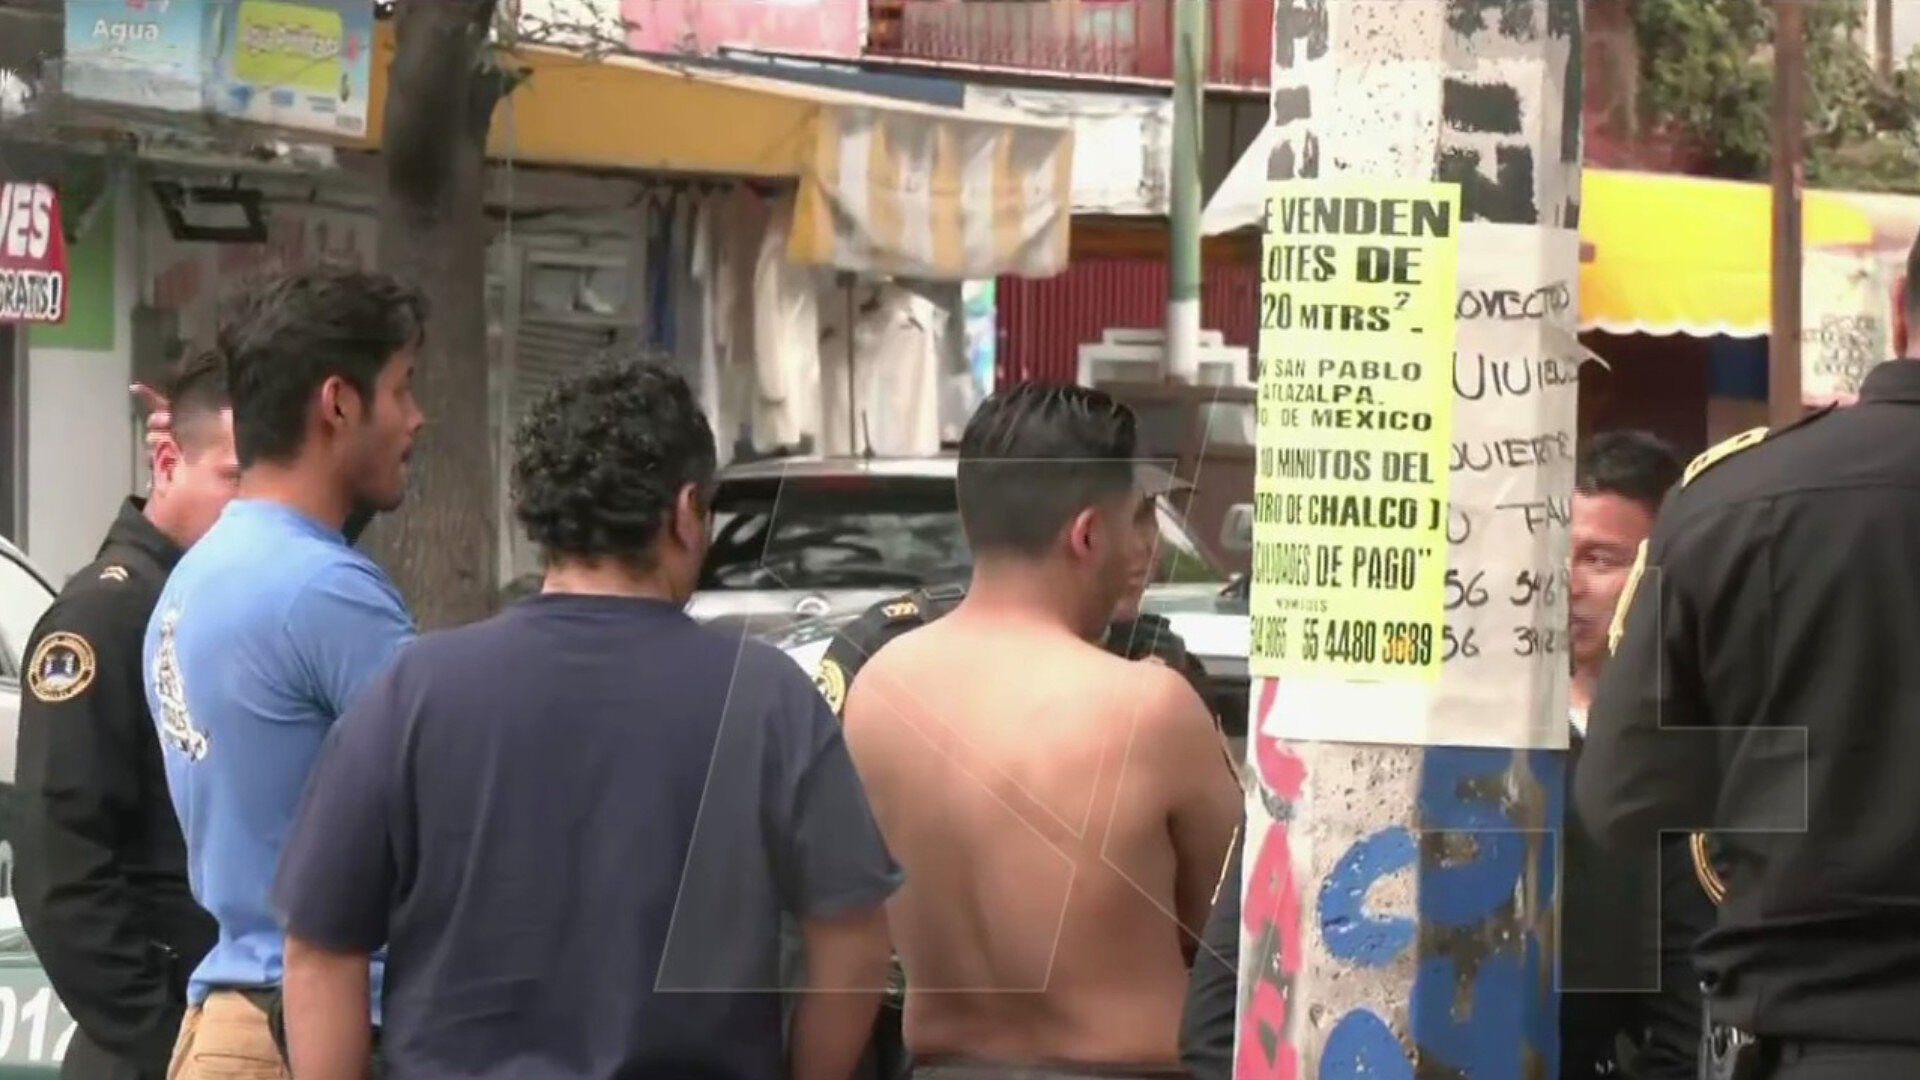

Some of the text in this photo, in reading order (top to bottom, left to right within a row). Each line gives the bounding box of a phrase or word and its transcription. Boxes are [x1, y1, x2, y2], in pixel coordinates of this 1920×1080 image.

[92, 19, 160, 43] Agua
[1281, 197, 1450, 237] VENDEN
[1261, 245, 1422, 285] OTES DE
[1275, 359, 1306, 378] SAN
[1318, 359, 1422, 381] PABLO
[1281, 408, 1298, 427] DE
[1311, 408, 1432, 432] MEXICO
[1277, 448, 1371, 481] MINUTOS
[1382, 451, 1434, 484] DEL
[1286, 494, 1303, 525] DE
[1308, 494, 1417, 529] CHALCO
[1316, 544, 1343, 588] DE
[1352, 546, 1431, 590] PAGO"
[1444, 569, 1488, 611] 56
[1325, 619, 1376, 663] 4480
[1381, 621, 1433, 666] 3689
[1441, 624, 1480, 663] 56
